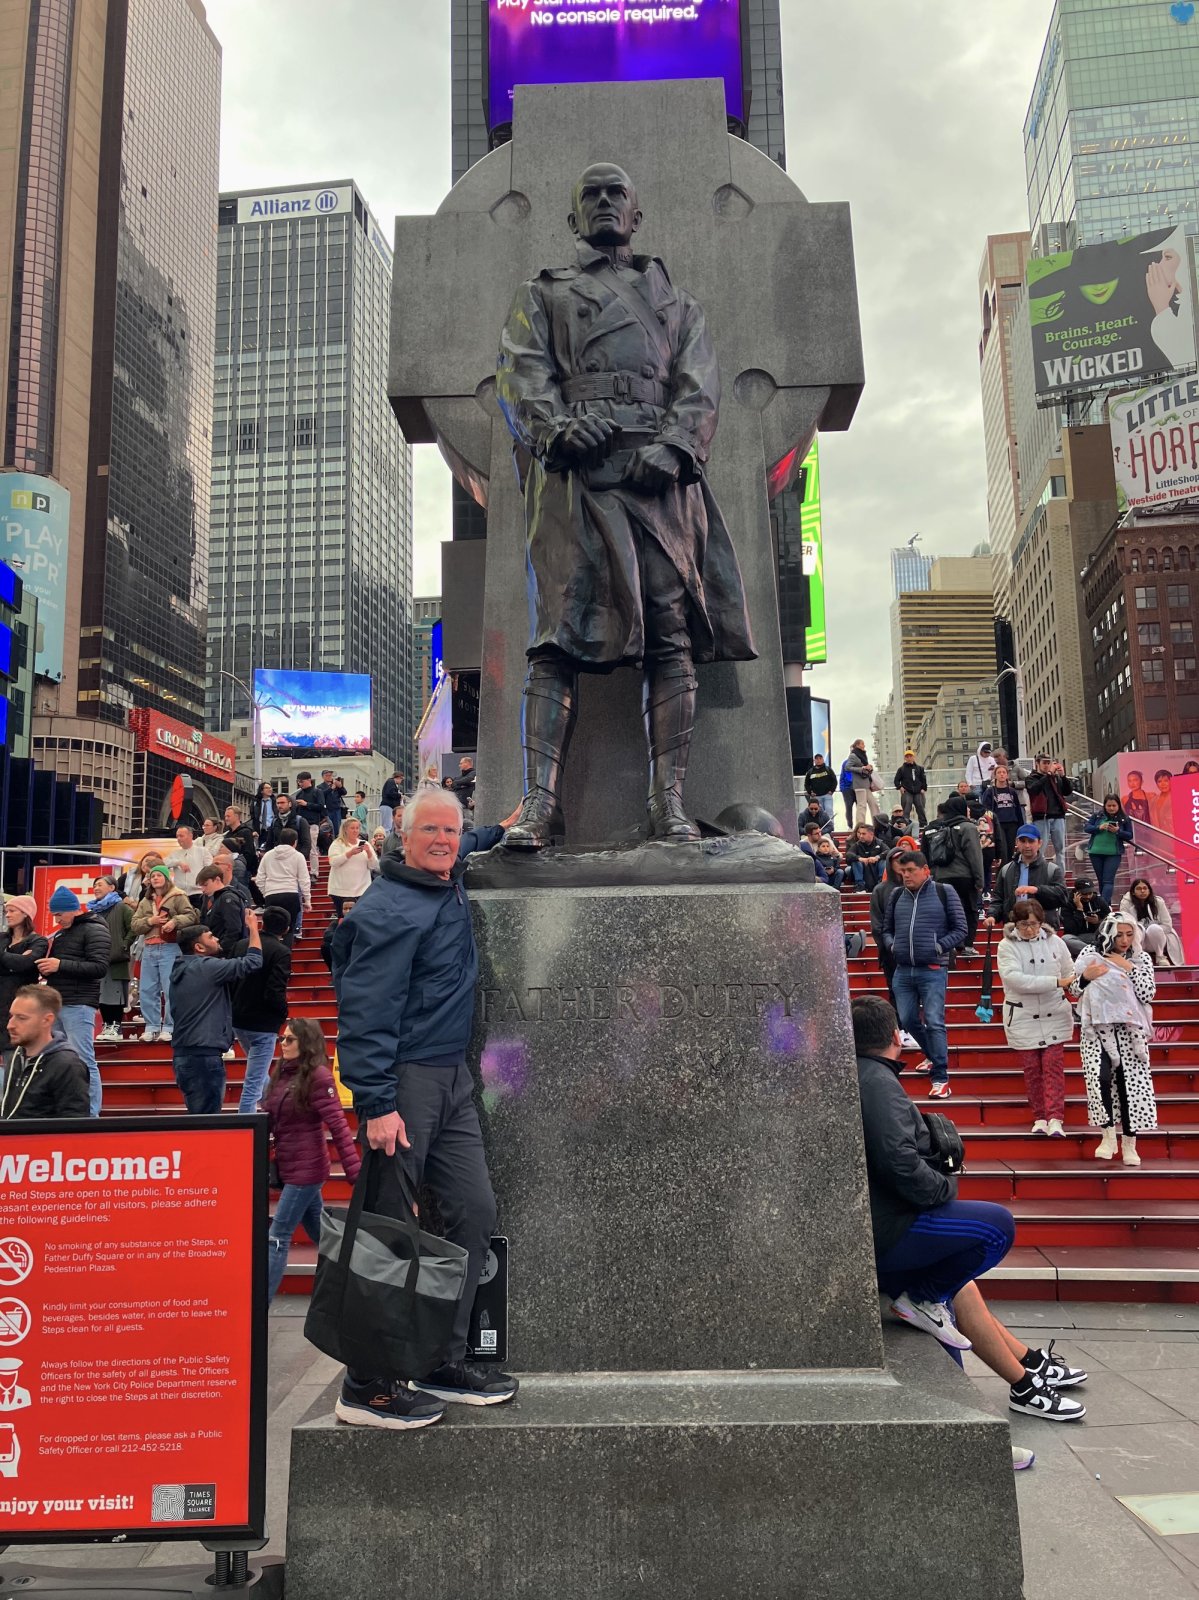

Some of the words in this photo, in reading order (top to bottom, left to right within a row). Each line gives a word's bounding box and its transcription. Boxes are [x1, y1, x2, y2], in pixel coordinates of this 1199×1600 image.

[531, 10, 553, 24] No
[556, 8, 620, 23] console
[624, 5, 699, 24] required.
[250, 199, 311, 216] Allianz
[1045, 325, 1092, 343] Brains.
[1095, 314, 1138, 333] Heart.
[1062, 333, 1122, 352] Courage.
[1126, 380, 1199, 433] LITTLE
[1183, 408, 1199, 419] OF
[1128, 491, 1167, 507] Westside
[203, 748, 232, 769] PLAZA
[480, 985, 641, 1022] FATHER
[660, 982, 799, 1020] DUFFY
[0, 1151, 181, 1183] Welcome!
[8, 1190, 27, 1200] Red
[29, 1190, 56, 1200] Steps
[76, 1190, 100, 1199] open
[102, 1189, 112, 1197] to
[113, 1188, 129, 1196] the
[131, 1187, 161, 1198] public.
[164, 1186, 175, 1195] To
[176, 1187, 209, 1195] ensure
[211, 1186, 218, 1194] a
[31, 1203, 82, 1213] experience
[84, 1201, 97, 1210] for
[99, 1200, 110, 1209] all
[112, 1201, 148, 1209] visitors,
[150, 1199, 182, 1209] please
[183, 1198, 217, 1207] adhere
[17, 1215, 58, 1225] following
[60, 1214, 110, 1225] guidelines:
[44, 1242, 56, 1250] No
[58, 1242, 92, 1251] smoking
[94, 1241, 102, 1249] of
[120, 1240, 162, 1248] substance
[191, 1238, 216, 1246] Steps,
[44, 1253, 70, 1262] Father
[72, 1252, 93, 1262] Duffy
[95, 1252, 124, 1261] Square
[126, 1252, 134, 1260] or
[146, 1252, 160, 1260] any
[162, 1250, 171, 1258] of
[172, 1250, 186, 1258] the
[187, 1249, 226, 1258] Broadway
[43, 1265, 87, 1273] Pedestrian
[89, 1263, 117, 1272] Plazas.
[42, 1302, 68, 1311] Kindly
[69, 1302, 87, 1310] limit
[88, 1302, 106, 1310] your
[108, 1300, 160, 1309] consumption
[162, 1298, 171, 1307] of
[172, 1298, 190, 1306] food
[192, 1298, 208, 1306] and
[42, 1314, 85, 1323] beverages,
[88, 1312, 119, 1320] besides
[157, 1310, 179, 1318] order
[180, 1310, 189, 1318] to
[214, 1308, 228, 1316] the
[41, 1325, 65, 1334] Steps
[66, 1325, 89, 1333] clean
[90, 1324, 102, 1332] for
[104, 1324, 114, 1332] all
[115, 1323, 144, 1333] guests.
[40, 1360, 68, 1369] Always
[69, 1359, 94, 1368] follow
[95, 1359, 109, 1367] the
[110, 1358, 151, 1366] directions
[152, 1356, 161, 1365] of
[162, 1356, 176, 1364] the
[178, 1355, 203, 1364] Public
[205, 1354, 230, 1364] Safety
[40, 1372, 72, 1380] Officers
[73, 1371, 84, 1379] for
[102, 1370, 126, 1379] safety
[128, 1369, 136, 1377] of
[138, 1369, 148, 1377] all
[150, 1368, 179, 1378] guests.
[181, 1367, 196, 1375] The
[198, 1366, 229, 1375] Officers
[40, 1384, 56, 1392] and
[58, 1383, 71, 1391] the
[73, 1383, 91, 1391] New
[93, 1382, 110, 1390] York
[112, 1381, 128, 1390] City
[130, 1380, 154, 1388] Police
[156, 1379, 204, 1389] Department
[40, 1395, 54, 1404] the
[55, 1395, 74, 1405] right
[85, 1394, 108, 1402] close
[109, 1393, 123, 1401] the
[124, 1392, 148, 1402] Steps
[149, 1392, 158, 1400] at
[160, 1392, 179, 1400] their
[180, 1390, 223, 1399] discretion.
[39, 1434, 52, 1443] For
[54, 1434, 88, 1443] dropped
[100, 1433, 115, 1441] lost
[117, 1433, 142, 1441] items,
[144, 1431, 172, 1441] please
[173, 1431, 188, 1439] ask
[197, 1429, 222, 1438] Public
[38, 1446, 64, 1456] Safety
[66, 1445, 92, 1454] Officer
[94, 1446, 103, 1454] or
[104, 1444, 120, 1453] call
[121, 1442, 184, 1452] 212-452-5218.
[43, 1500, 84, 1514] your
[88, 1496, 134, 1511] visit!
[187, 1498, 213, 1507] SQUARE
